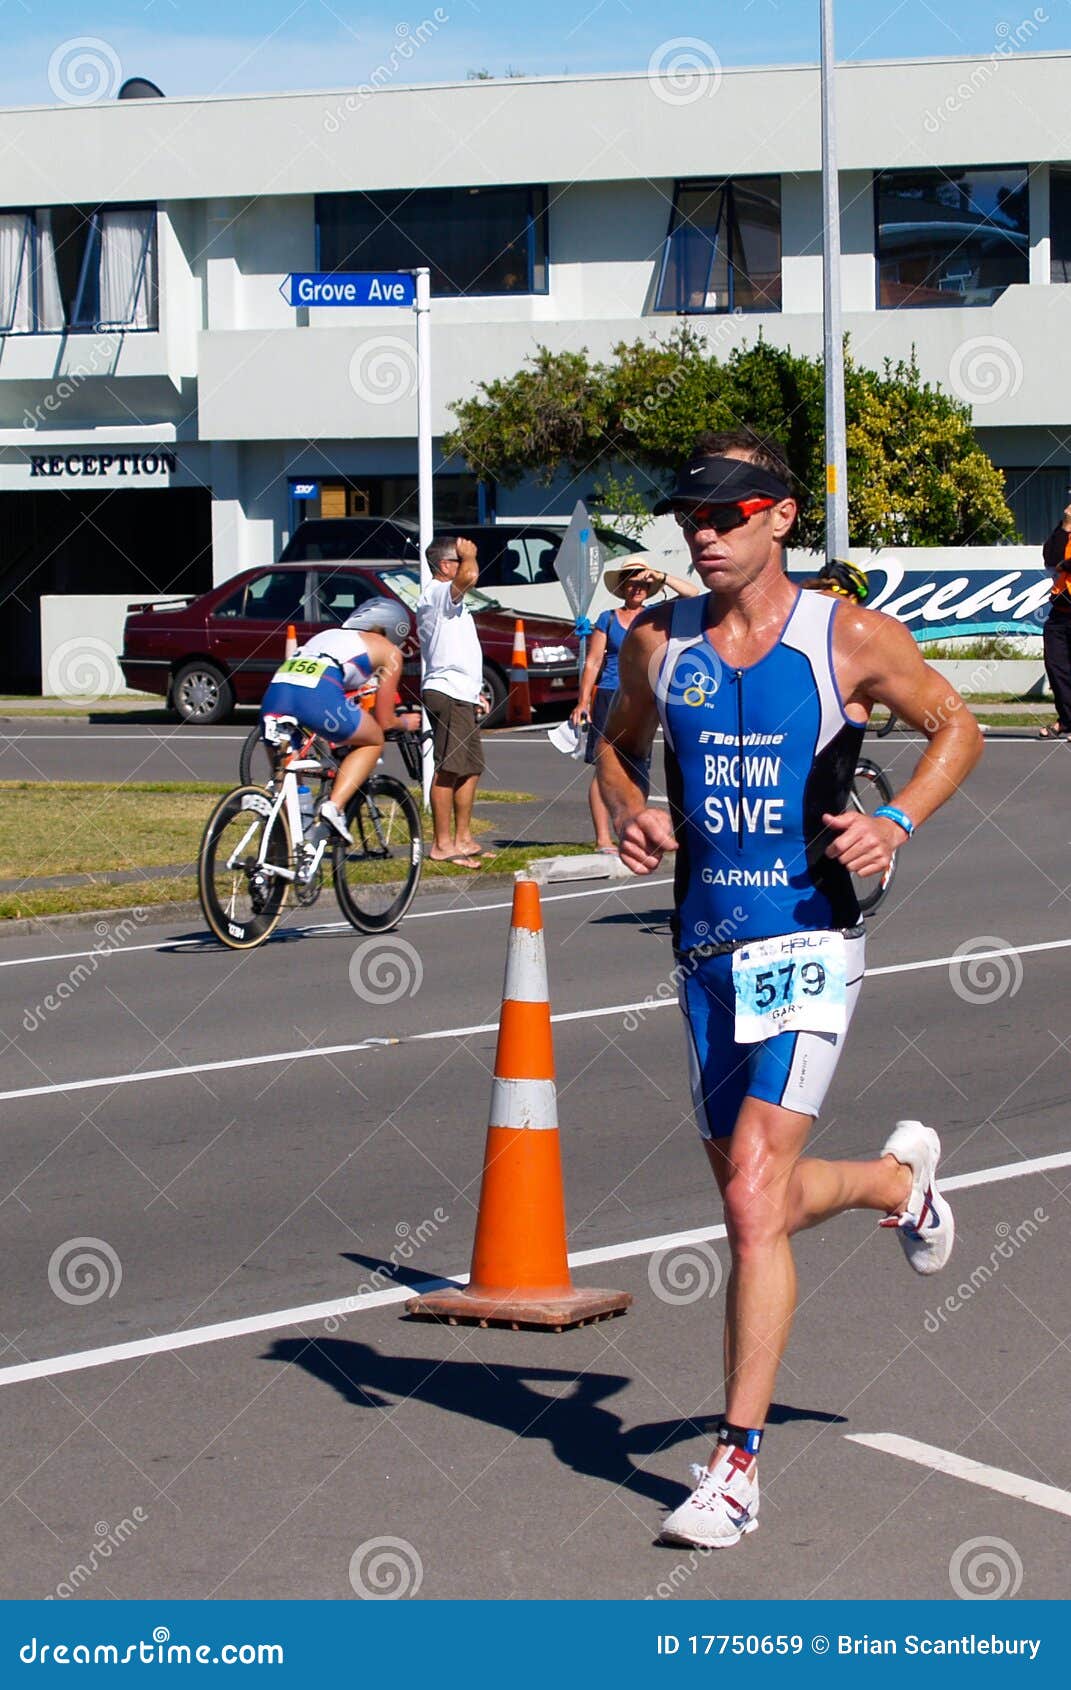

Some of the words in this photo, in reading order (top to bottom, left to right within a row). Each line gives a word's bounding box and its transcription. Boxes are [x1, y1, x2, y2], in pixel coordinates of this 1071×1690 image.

[298, 279, 356, 301] Grove
[368, 279, 405, 301] Ave
[30, 453, 176, 477] RECEPTION
[288, 661, 317, 674] 156
[704, 754, 781, 788] BROWN
[704, 796, 785, 834] SWE
[702, 865, 789, 887] GARMIN
[755, 962, 826, 1008] 579
